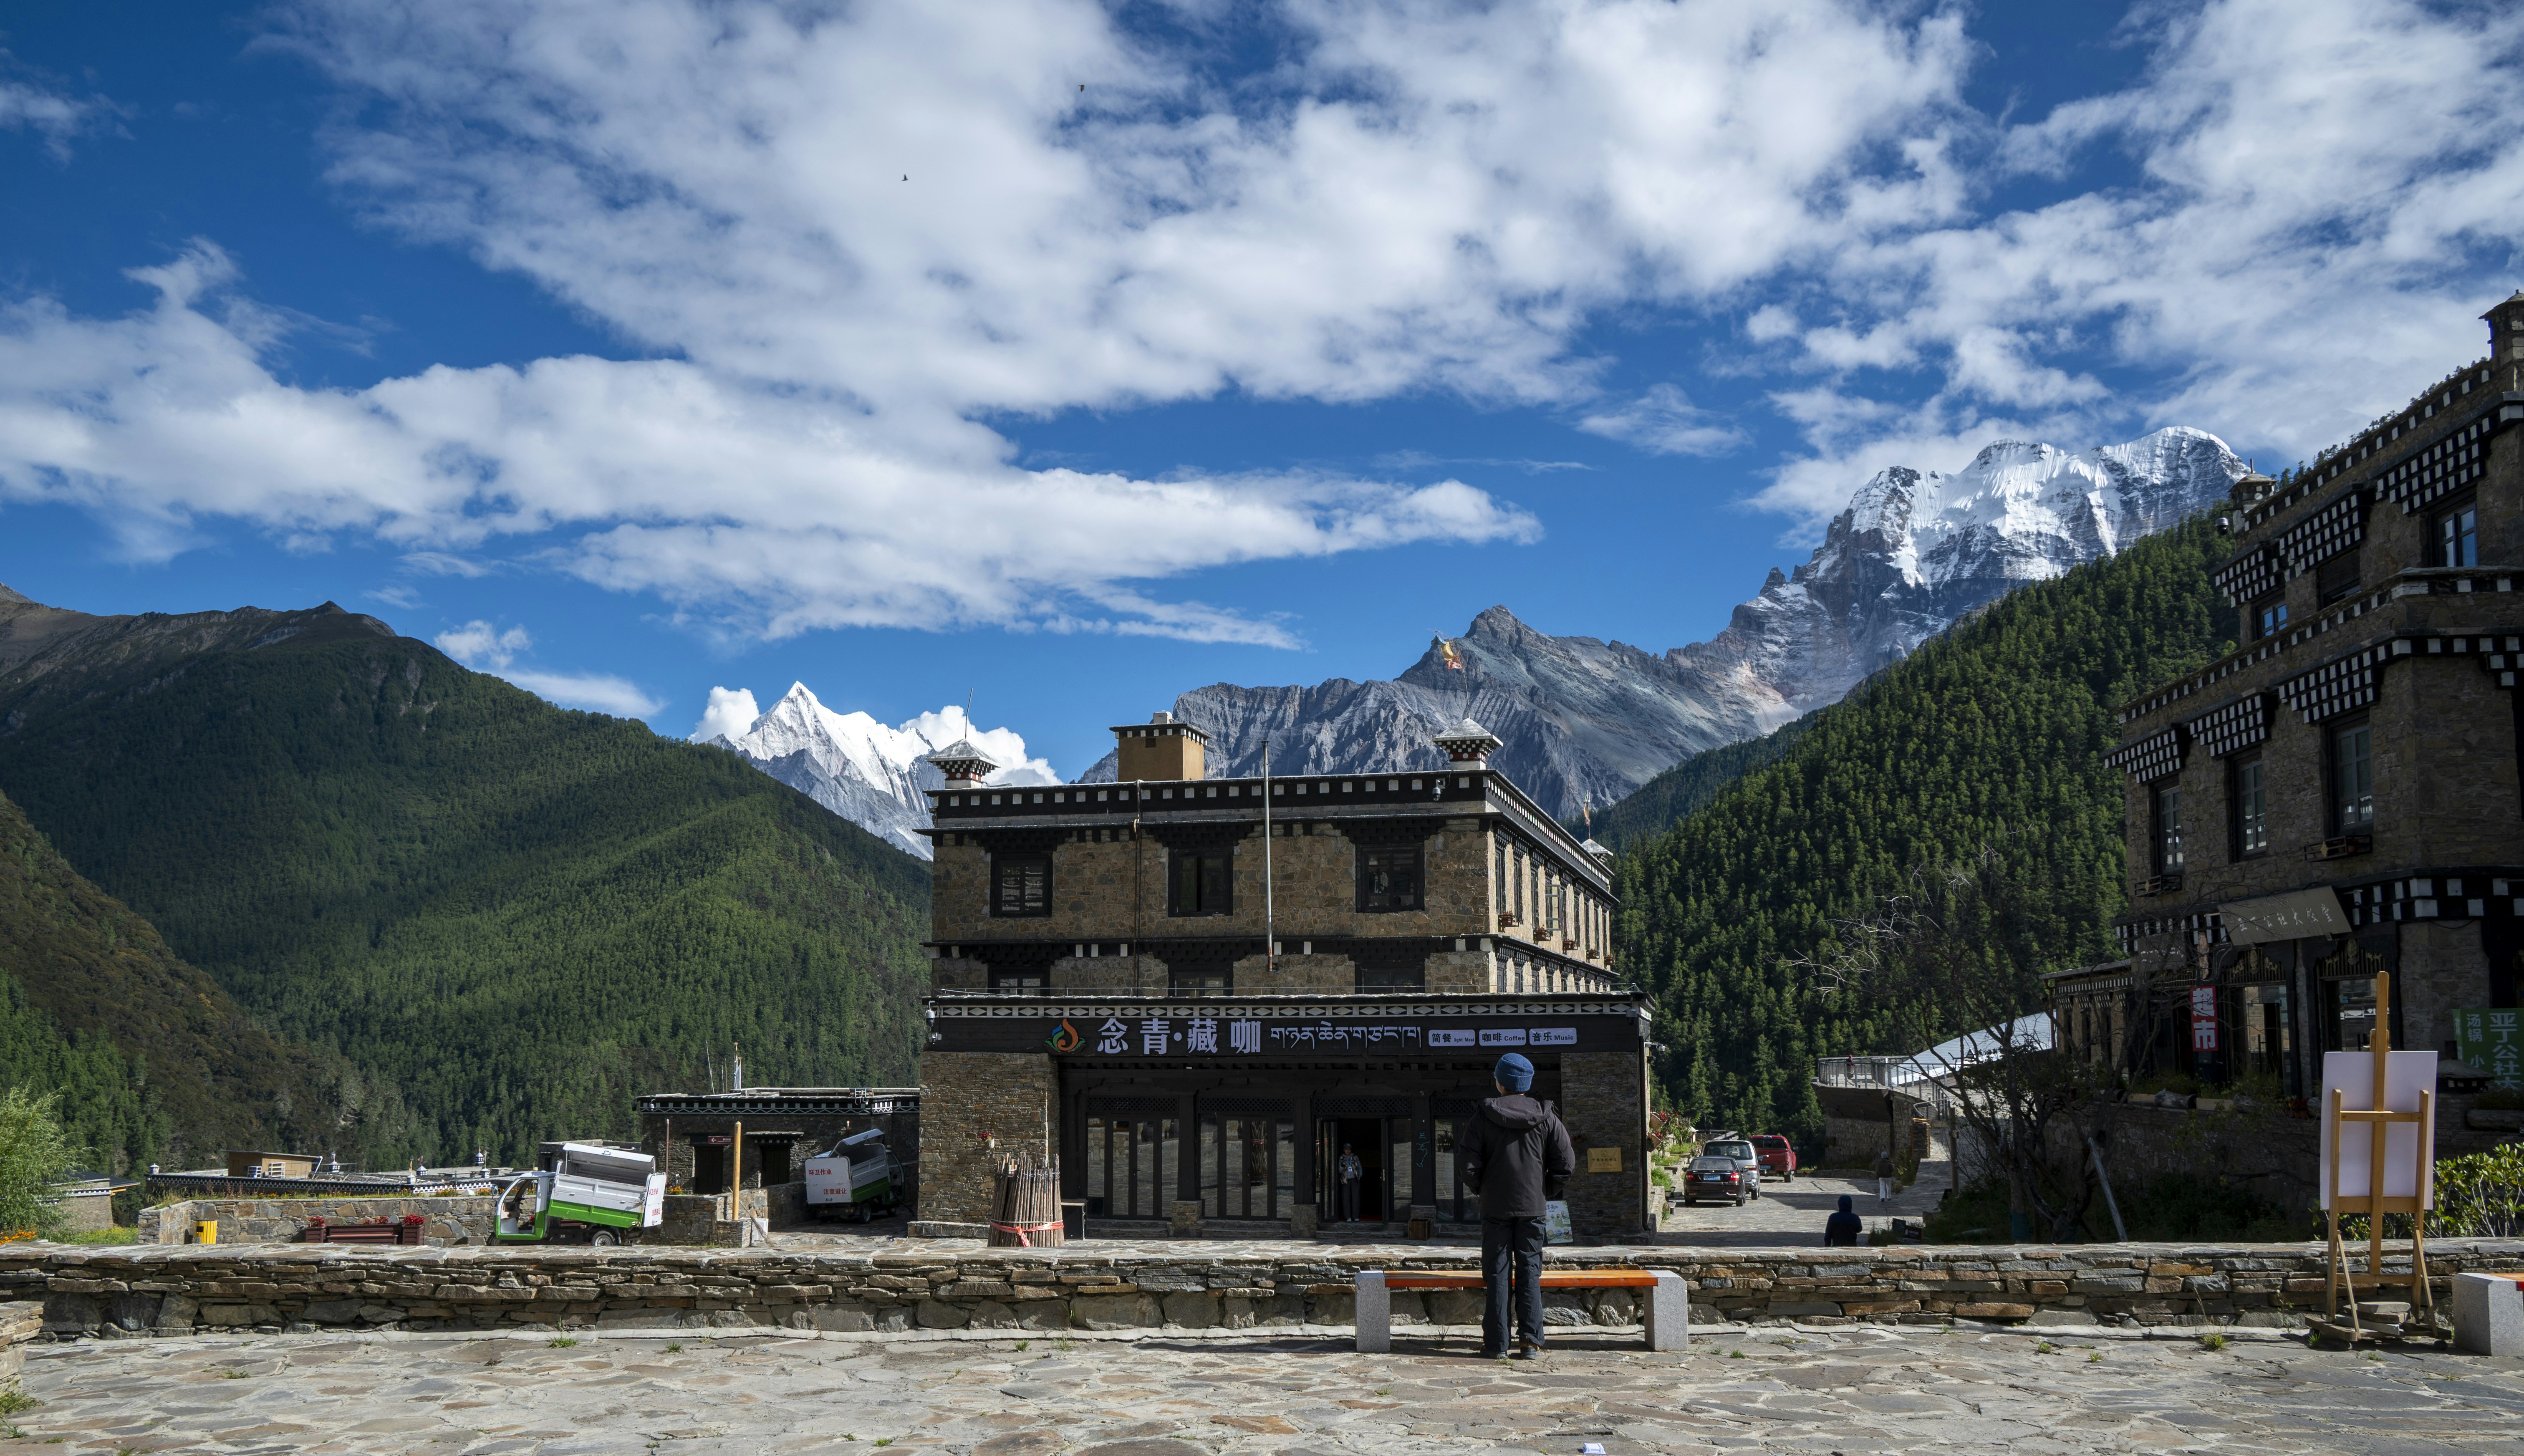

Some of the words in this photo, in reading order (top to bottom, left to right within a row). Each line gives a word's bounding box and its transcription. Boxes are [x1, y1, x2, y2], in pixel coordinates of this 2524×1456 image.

[2193, 987, 2215, 1049] 超市
[1098, 1018, 1261, 1055] 念青·藏咖
[1482, 1032, 1502, 1042] 咖啡
[1532, 1032, 1552, 1042] 音乐
[2466, 1014, 2483, 1042] 汤锅
[1431, 1033, 1451, 1043] 简餐
